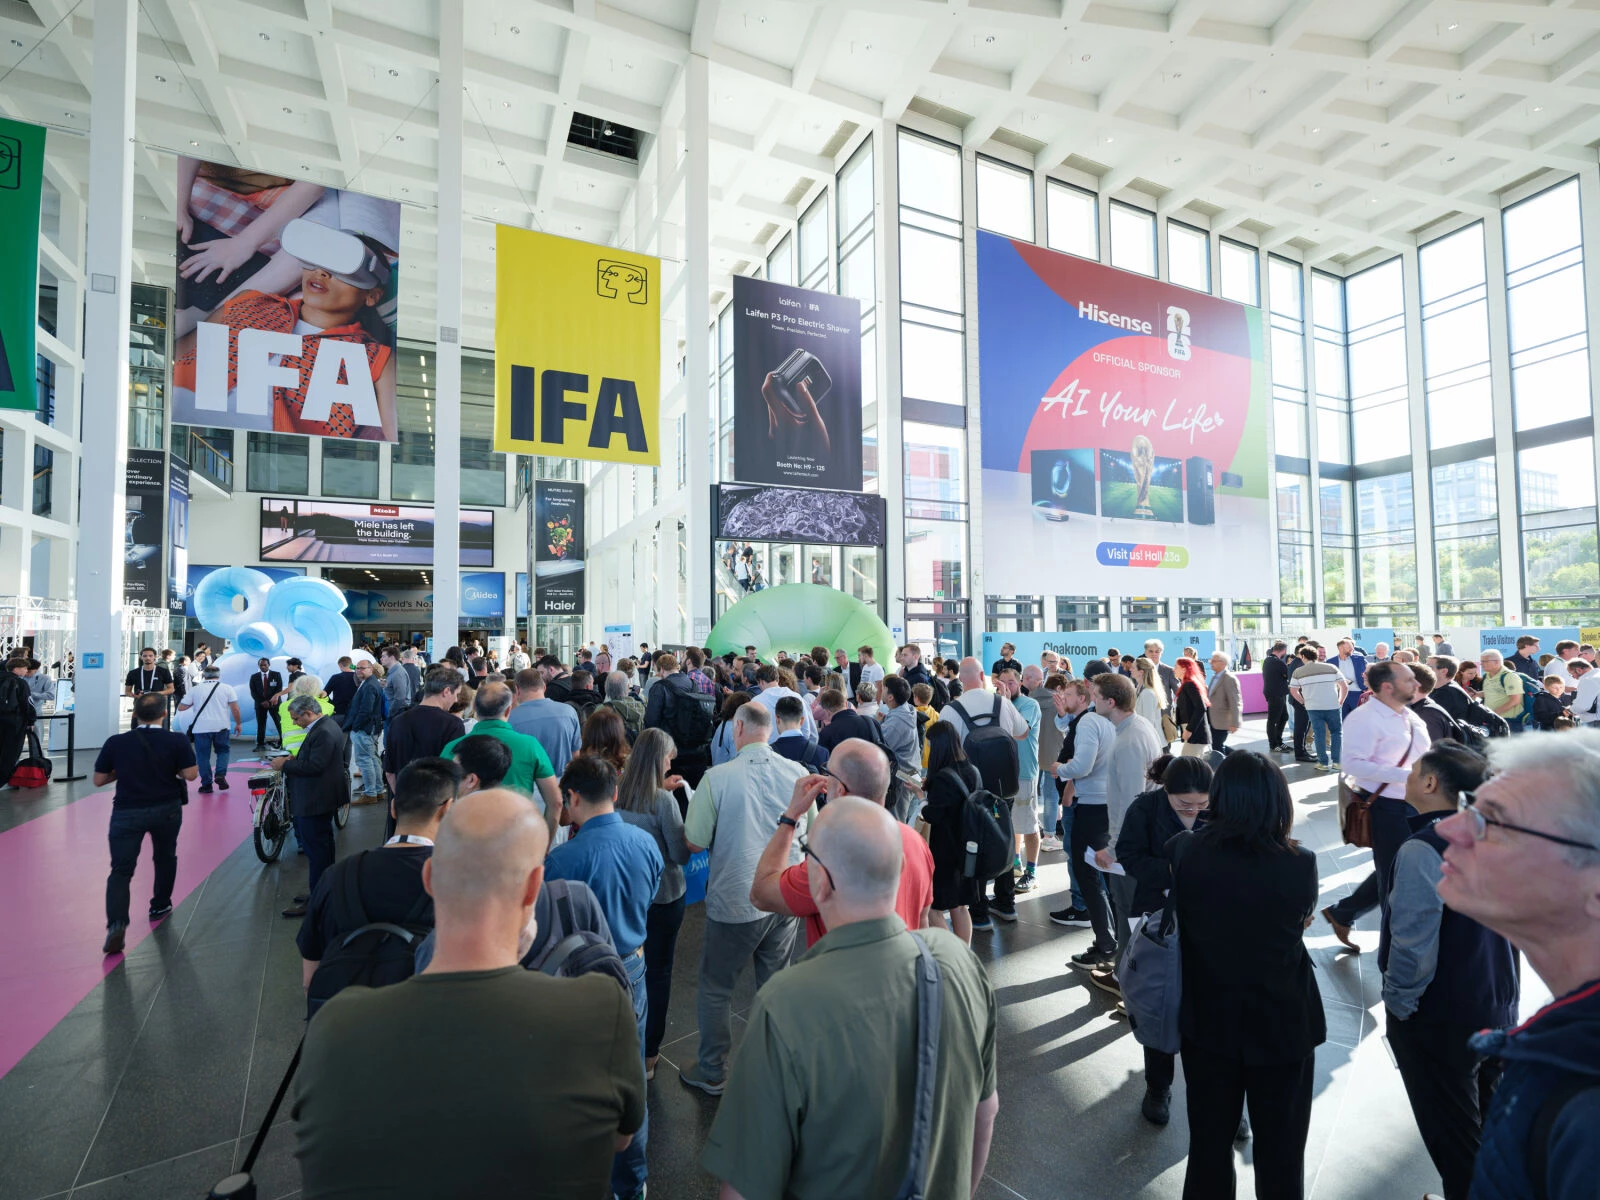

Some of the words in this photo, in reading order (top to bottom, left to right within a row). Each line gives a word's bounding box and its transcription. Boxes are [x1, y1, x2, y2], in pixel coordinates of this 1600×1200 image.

[809, 303, 820, 312] IFA
[745, 308, 769, 319] Laifen
[771, 312, 781, 321] P3
[783, 315, 796, 324] Pro
[798, 318, 825, 330] Electric
[826, 323, 850, 334] Shaver
[1078, 300, 1152, 335] Hisense
[1093, 352, 1136, 370] OFFICIAL
[1138, 361, 1181, 380] SPONSOR
[194, 321, 383, 428] IFA
[510, 364, 649, 453] IFA
[1041, 379, 1091, 419] AI
[1099, 391, 1157, 428] Your
[354, 520, 380, 529] Miele
[382, 521, 398, 530] has
[400, 522, 415, 531] left
[356, 528, 372, 537] the
[374, 529, 412, 540] building.
[1106, 547, 1128, 560] Visit
[1129, 550, 1143, 560] us!
[1144, 550, 1162, 561] Hall
[1164, 551, 1181, 562] 23a
[469, 590, 498, 600] Midea
[125, 596, 147, 607] ier
[377, 600, 412, 608] World's
[544, 600, 576, 610] Haier
[1189, 636, 1200, 645] IFA
[1482, 635, 1497, 645] Trade
[1497, 635, 1516, 645] Visitors
